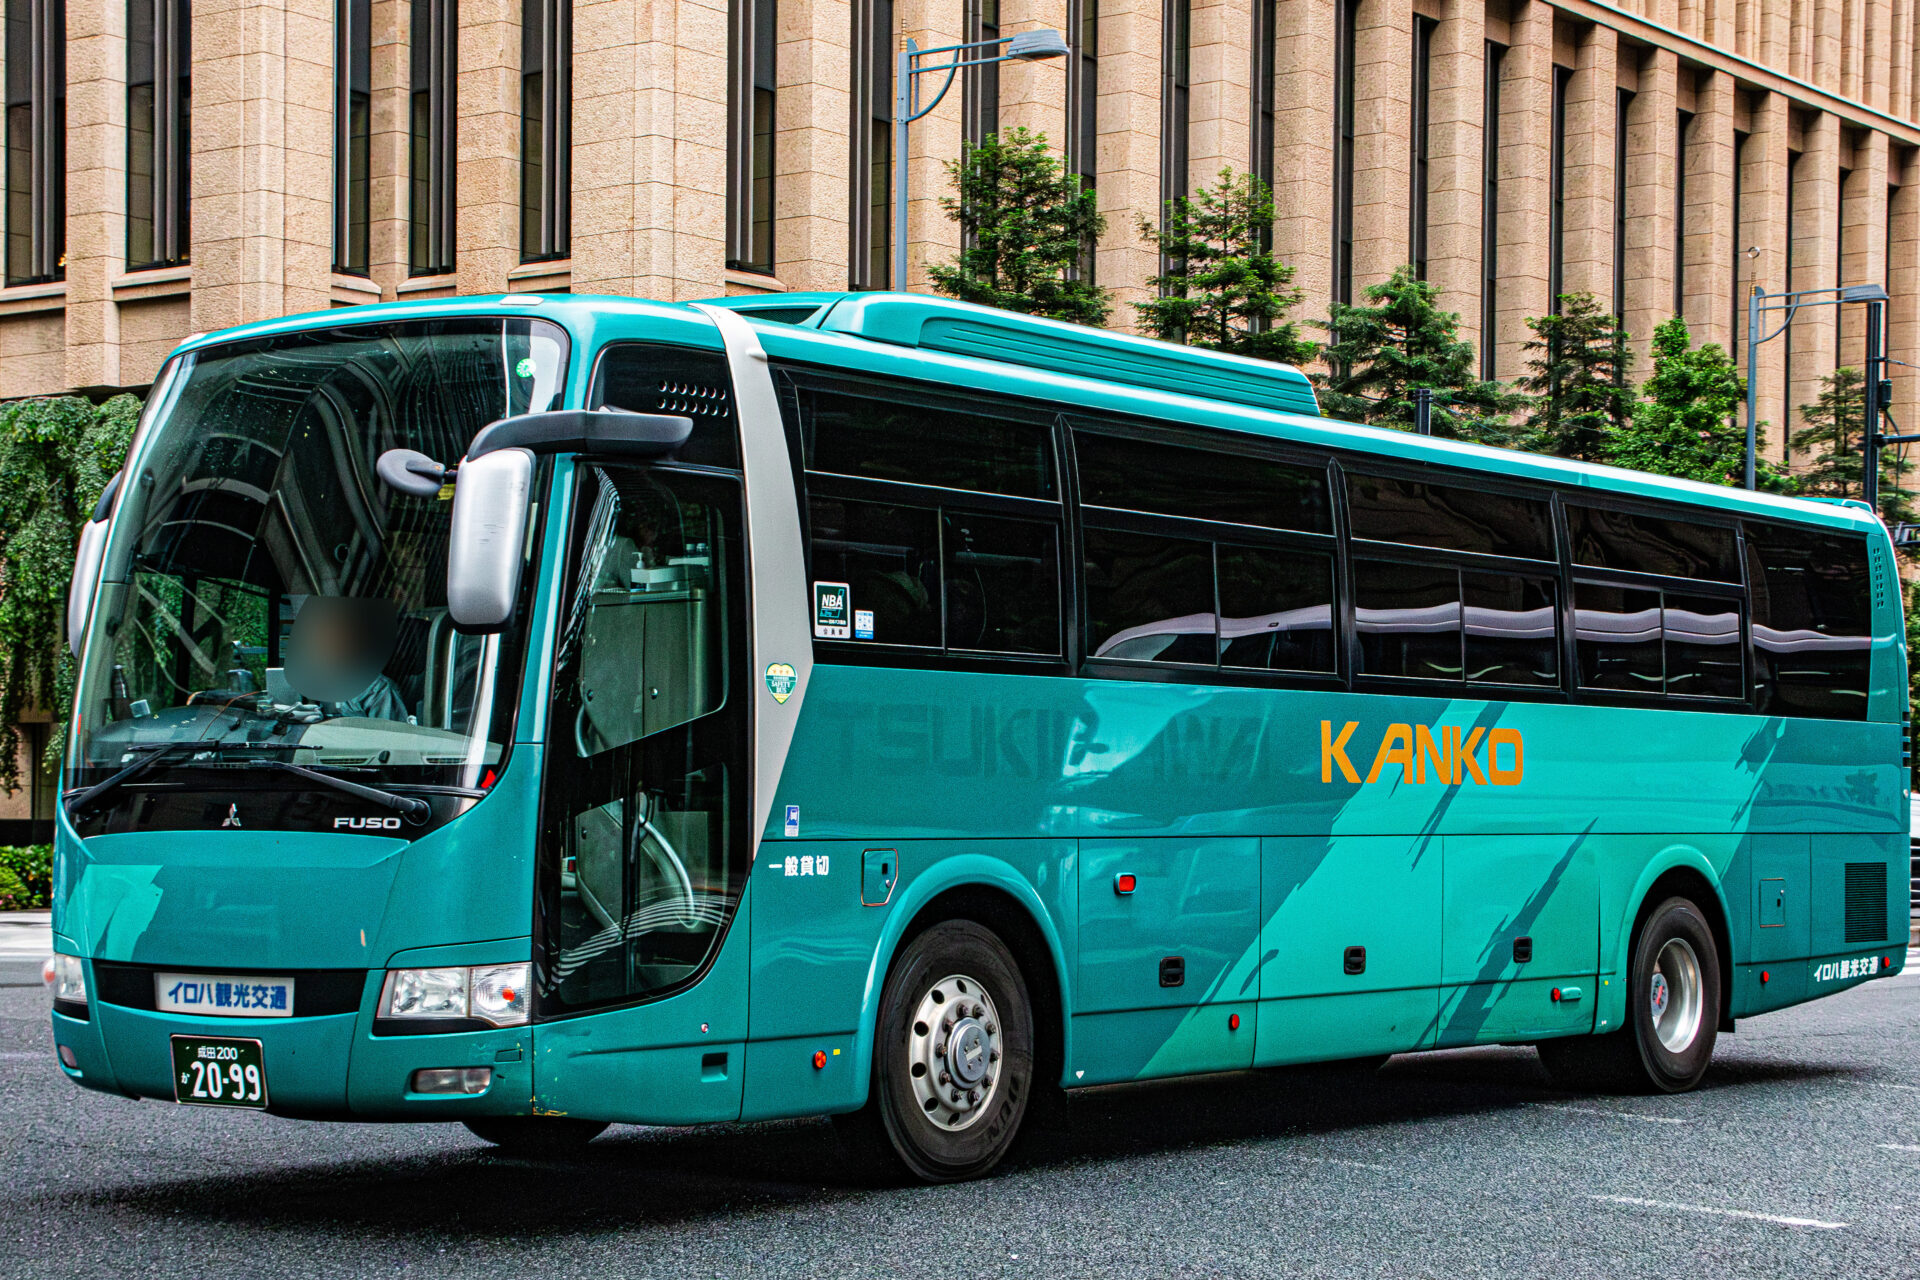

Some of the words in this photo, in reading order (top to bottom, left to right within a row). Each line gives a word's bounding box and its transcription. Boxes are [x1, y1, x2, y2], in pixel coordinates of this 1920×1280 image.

[821, 594, 843, 608] NBA
[1320, 719, 1524, 786] KANKO
[333, 817, 402, 829] FUSO
[768, 855, 830, 877] 一般貸切
[1813, 955, 1879, 982] イロハ観光交通
[168, 981, 287, 1010] イロハ観光交通
[190, 1060, 262, 1101] 20-99
